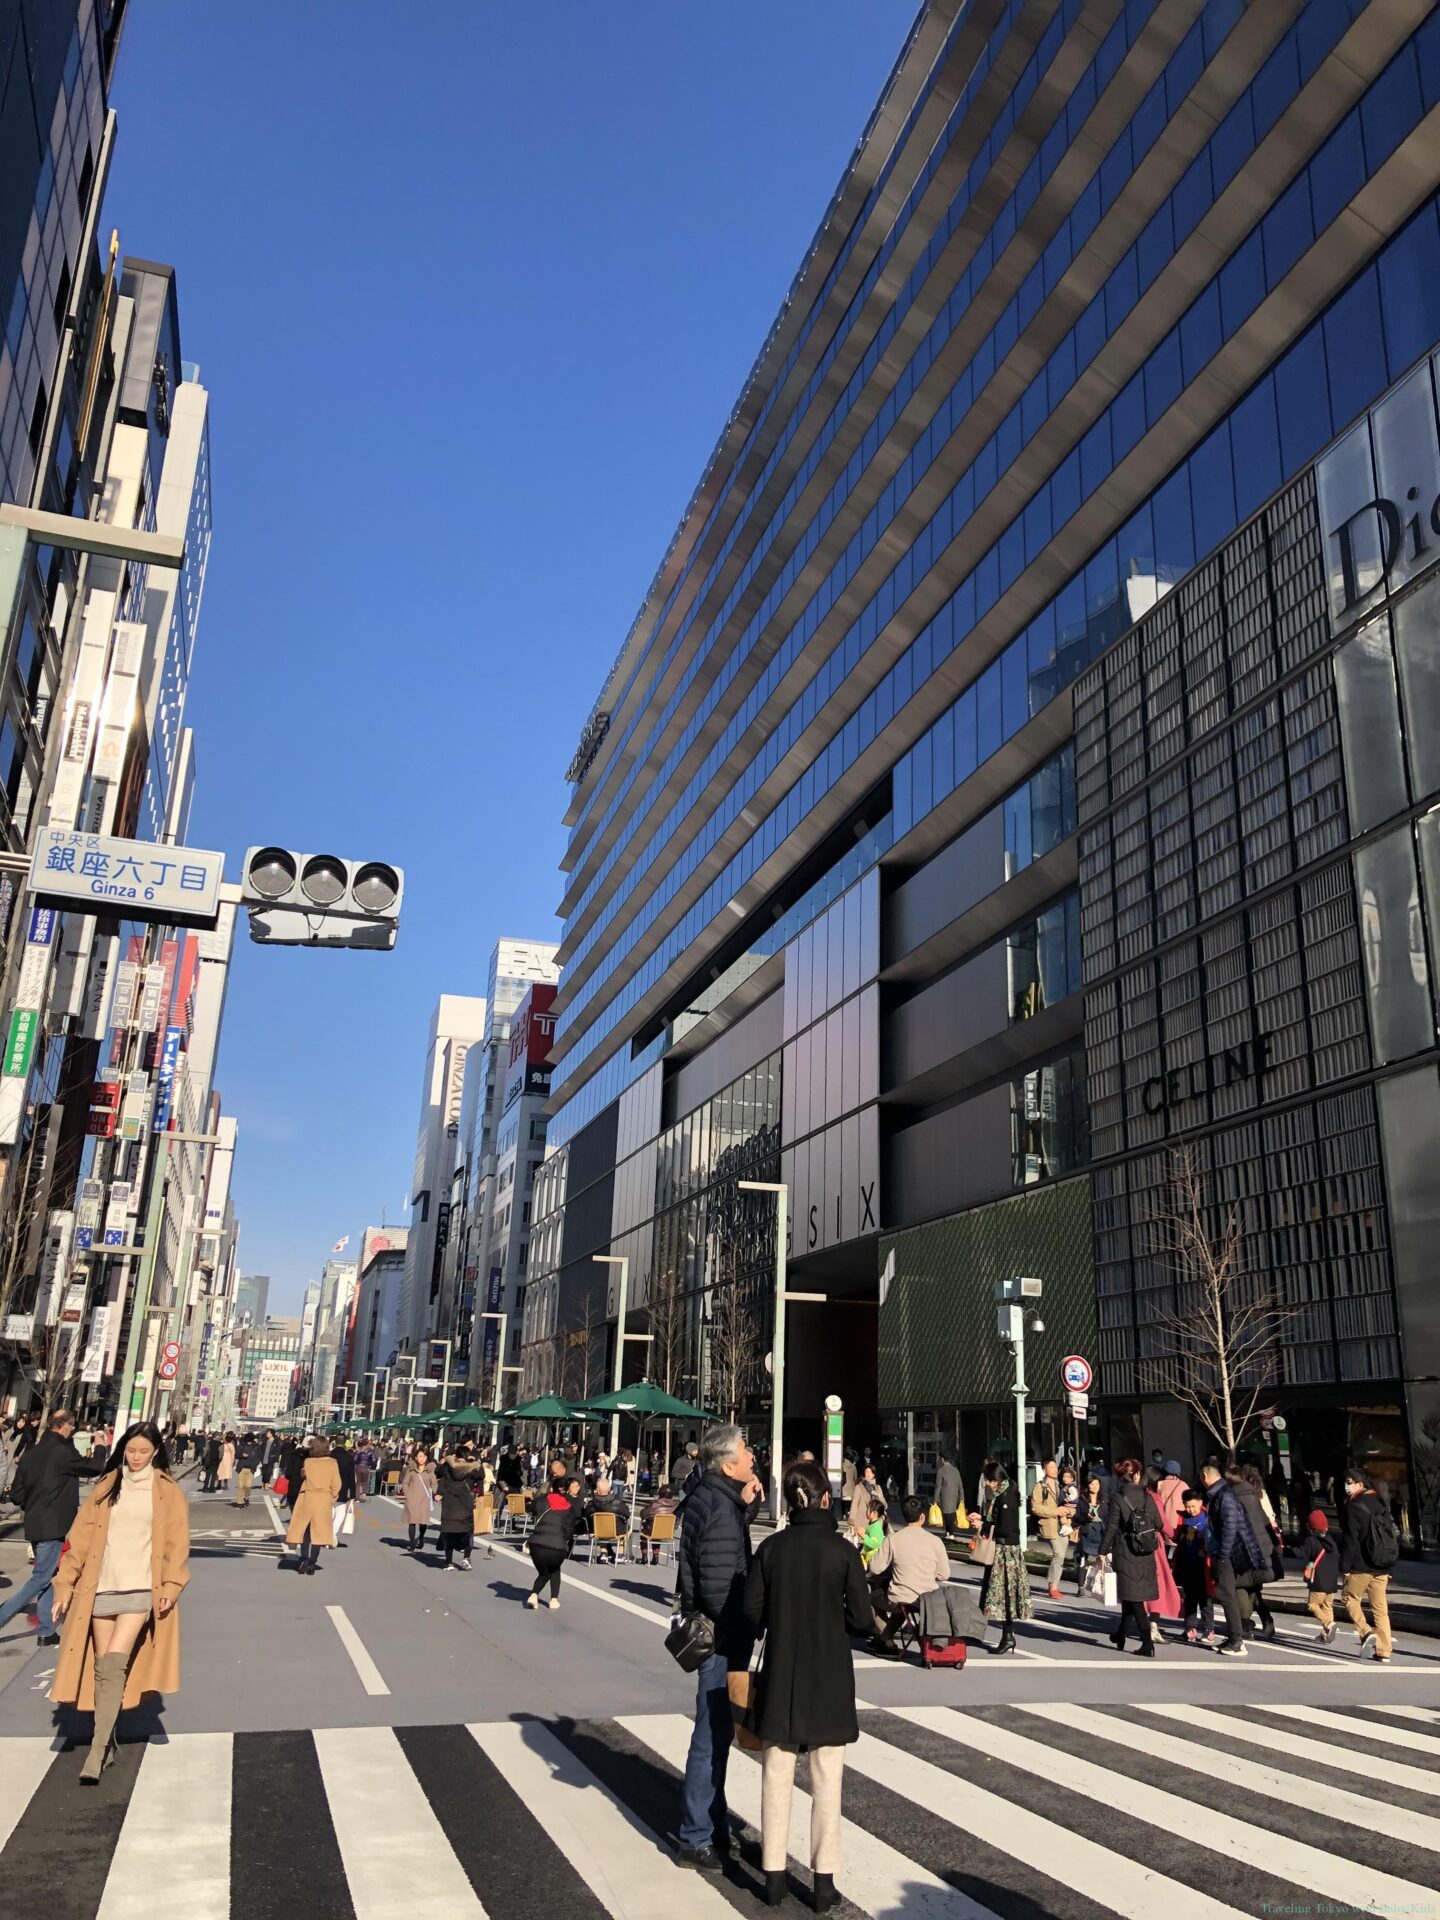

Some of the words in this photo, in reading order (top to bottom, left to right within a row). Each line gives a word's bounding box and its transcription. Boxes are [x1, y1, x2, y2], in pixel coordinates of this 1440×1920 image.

[50, 830, 102, 849] 中央区
[45, 845, 208, 892] 銀座六丁目
[91, 879, 136, 900] Ginza
[144, 888, 154, 900] 6
[91, 967, 109, 1012] DIANA
[10, 1012, 31, 1073] 西銀座診療所
[452, 1044, 468, 1095] GINZA
[1142, 1031, 1282, 1116] CELINE
[43, 1247, 63, 1296] DIANA
[607, 1271, 652, 1316] GIX
[264, 1363, 290, 1372] LIXIL
